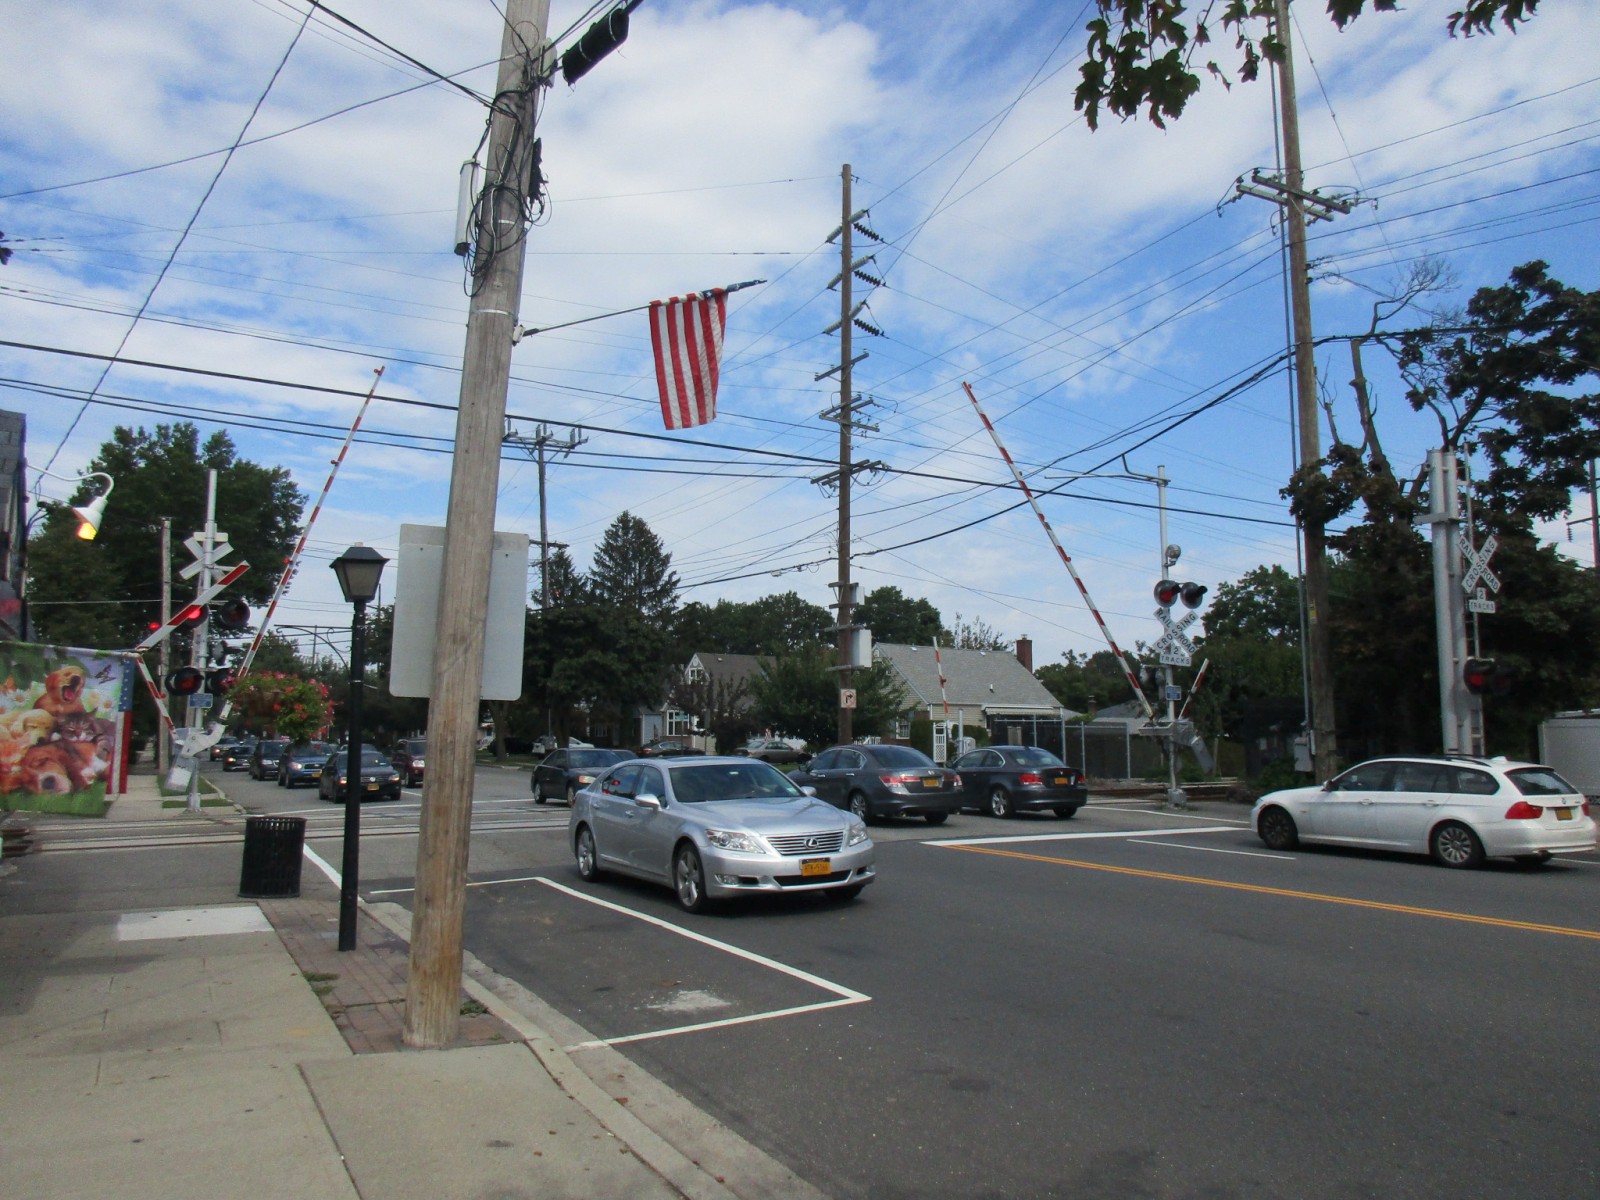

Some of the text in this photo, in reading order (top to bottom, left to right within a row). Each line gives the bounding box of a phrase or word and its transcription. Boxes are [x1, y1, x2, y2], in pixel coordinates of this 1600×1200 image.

[1459, 539, 1499, 590] RAIL ROAD
[1466, 541, 1496, 588] CROSSING
[1470, 601, 1494, 611] TRACKS
[1479, 591, 1485, 600] 2
[1156, 613, 1196, 649] CROSSING
[1157, 607, 1196, 653] RAIL ROAD
[1160, 655, 1190, 665] TRACKS
[1173, 645, 1180, 655] 2
